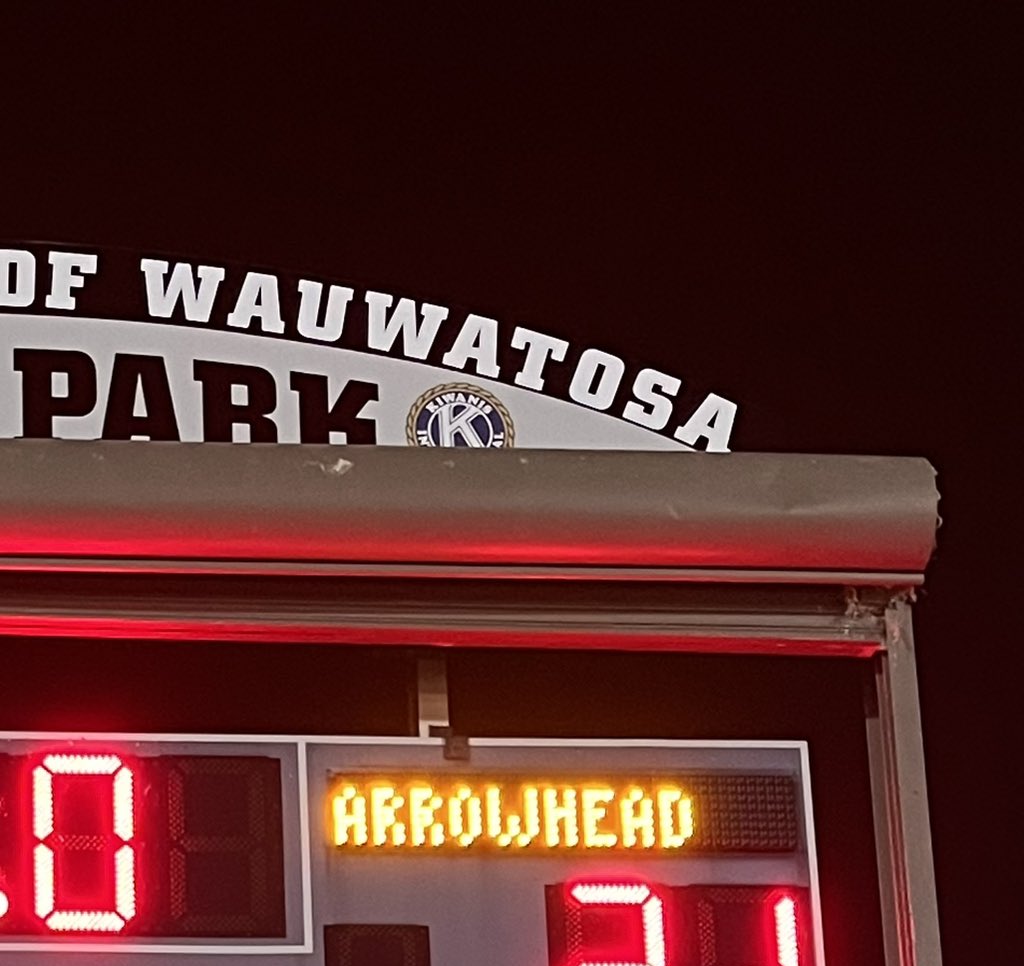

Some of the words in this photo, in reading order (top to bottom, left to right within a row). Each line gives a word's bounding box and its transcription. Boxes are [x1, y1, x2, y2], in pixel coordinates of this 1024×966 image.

[140, 258, 739, 453] WAUWATOSA
[13, 348, 379, 445] PARK
[425, 392, 494, 414] KIWANIS
[331, 785, 695, 849] ARROWHEAD
